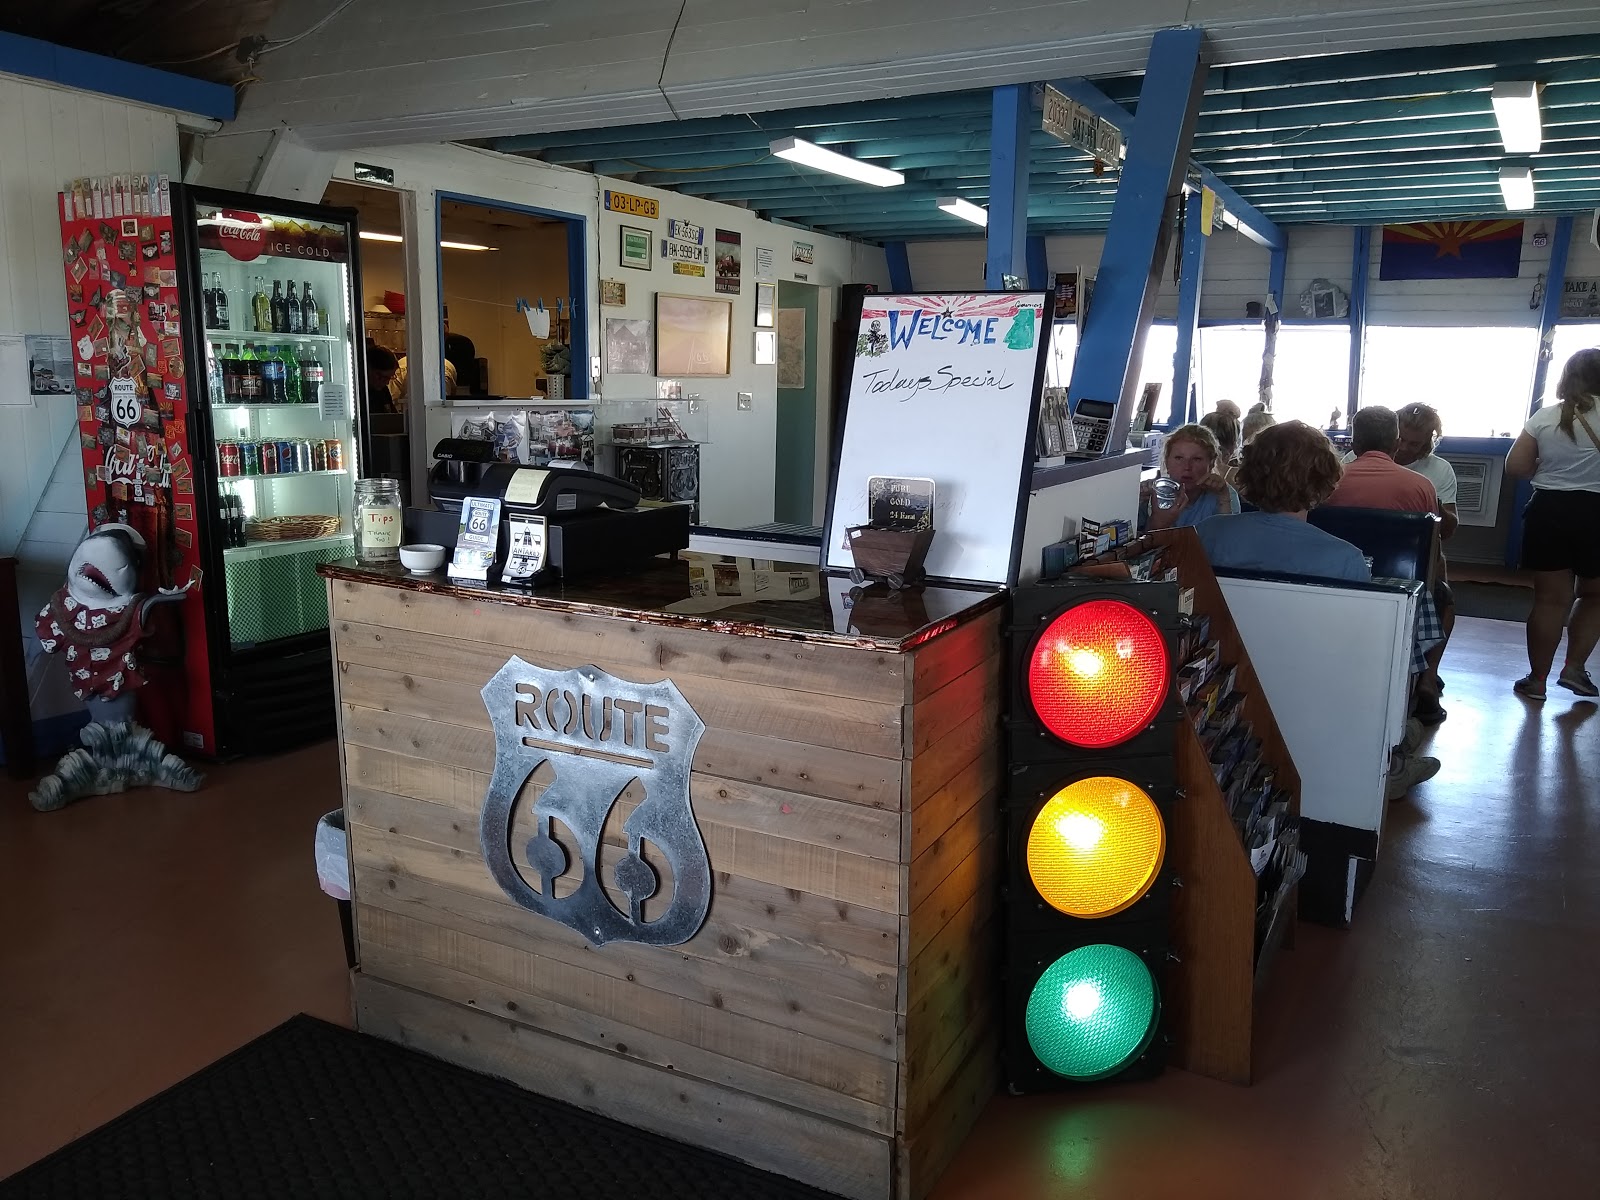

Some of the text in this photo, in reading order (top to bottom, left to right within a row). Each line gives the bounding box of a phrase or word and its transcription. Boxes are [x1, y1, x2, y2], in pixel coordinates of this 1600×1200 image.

[613, 195, 656, 215] 03-LP-GB
[271, 242, 330, 257] ICE COLD
[1564, 281, 1587, 293] TAKE
[888, 309, 999, 351] WELCOME
[929, 365, 1014, 394] Special
[116, 398, 136, 420] 66
[889, 498, 911, 506] GOLD
[368, 513, 394, 525] Tips
[471, 518, 486, 531] 66
[514, 682, 670, 753] ROUTE
[506, 758, 676, 924] 66
